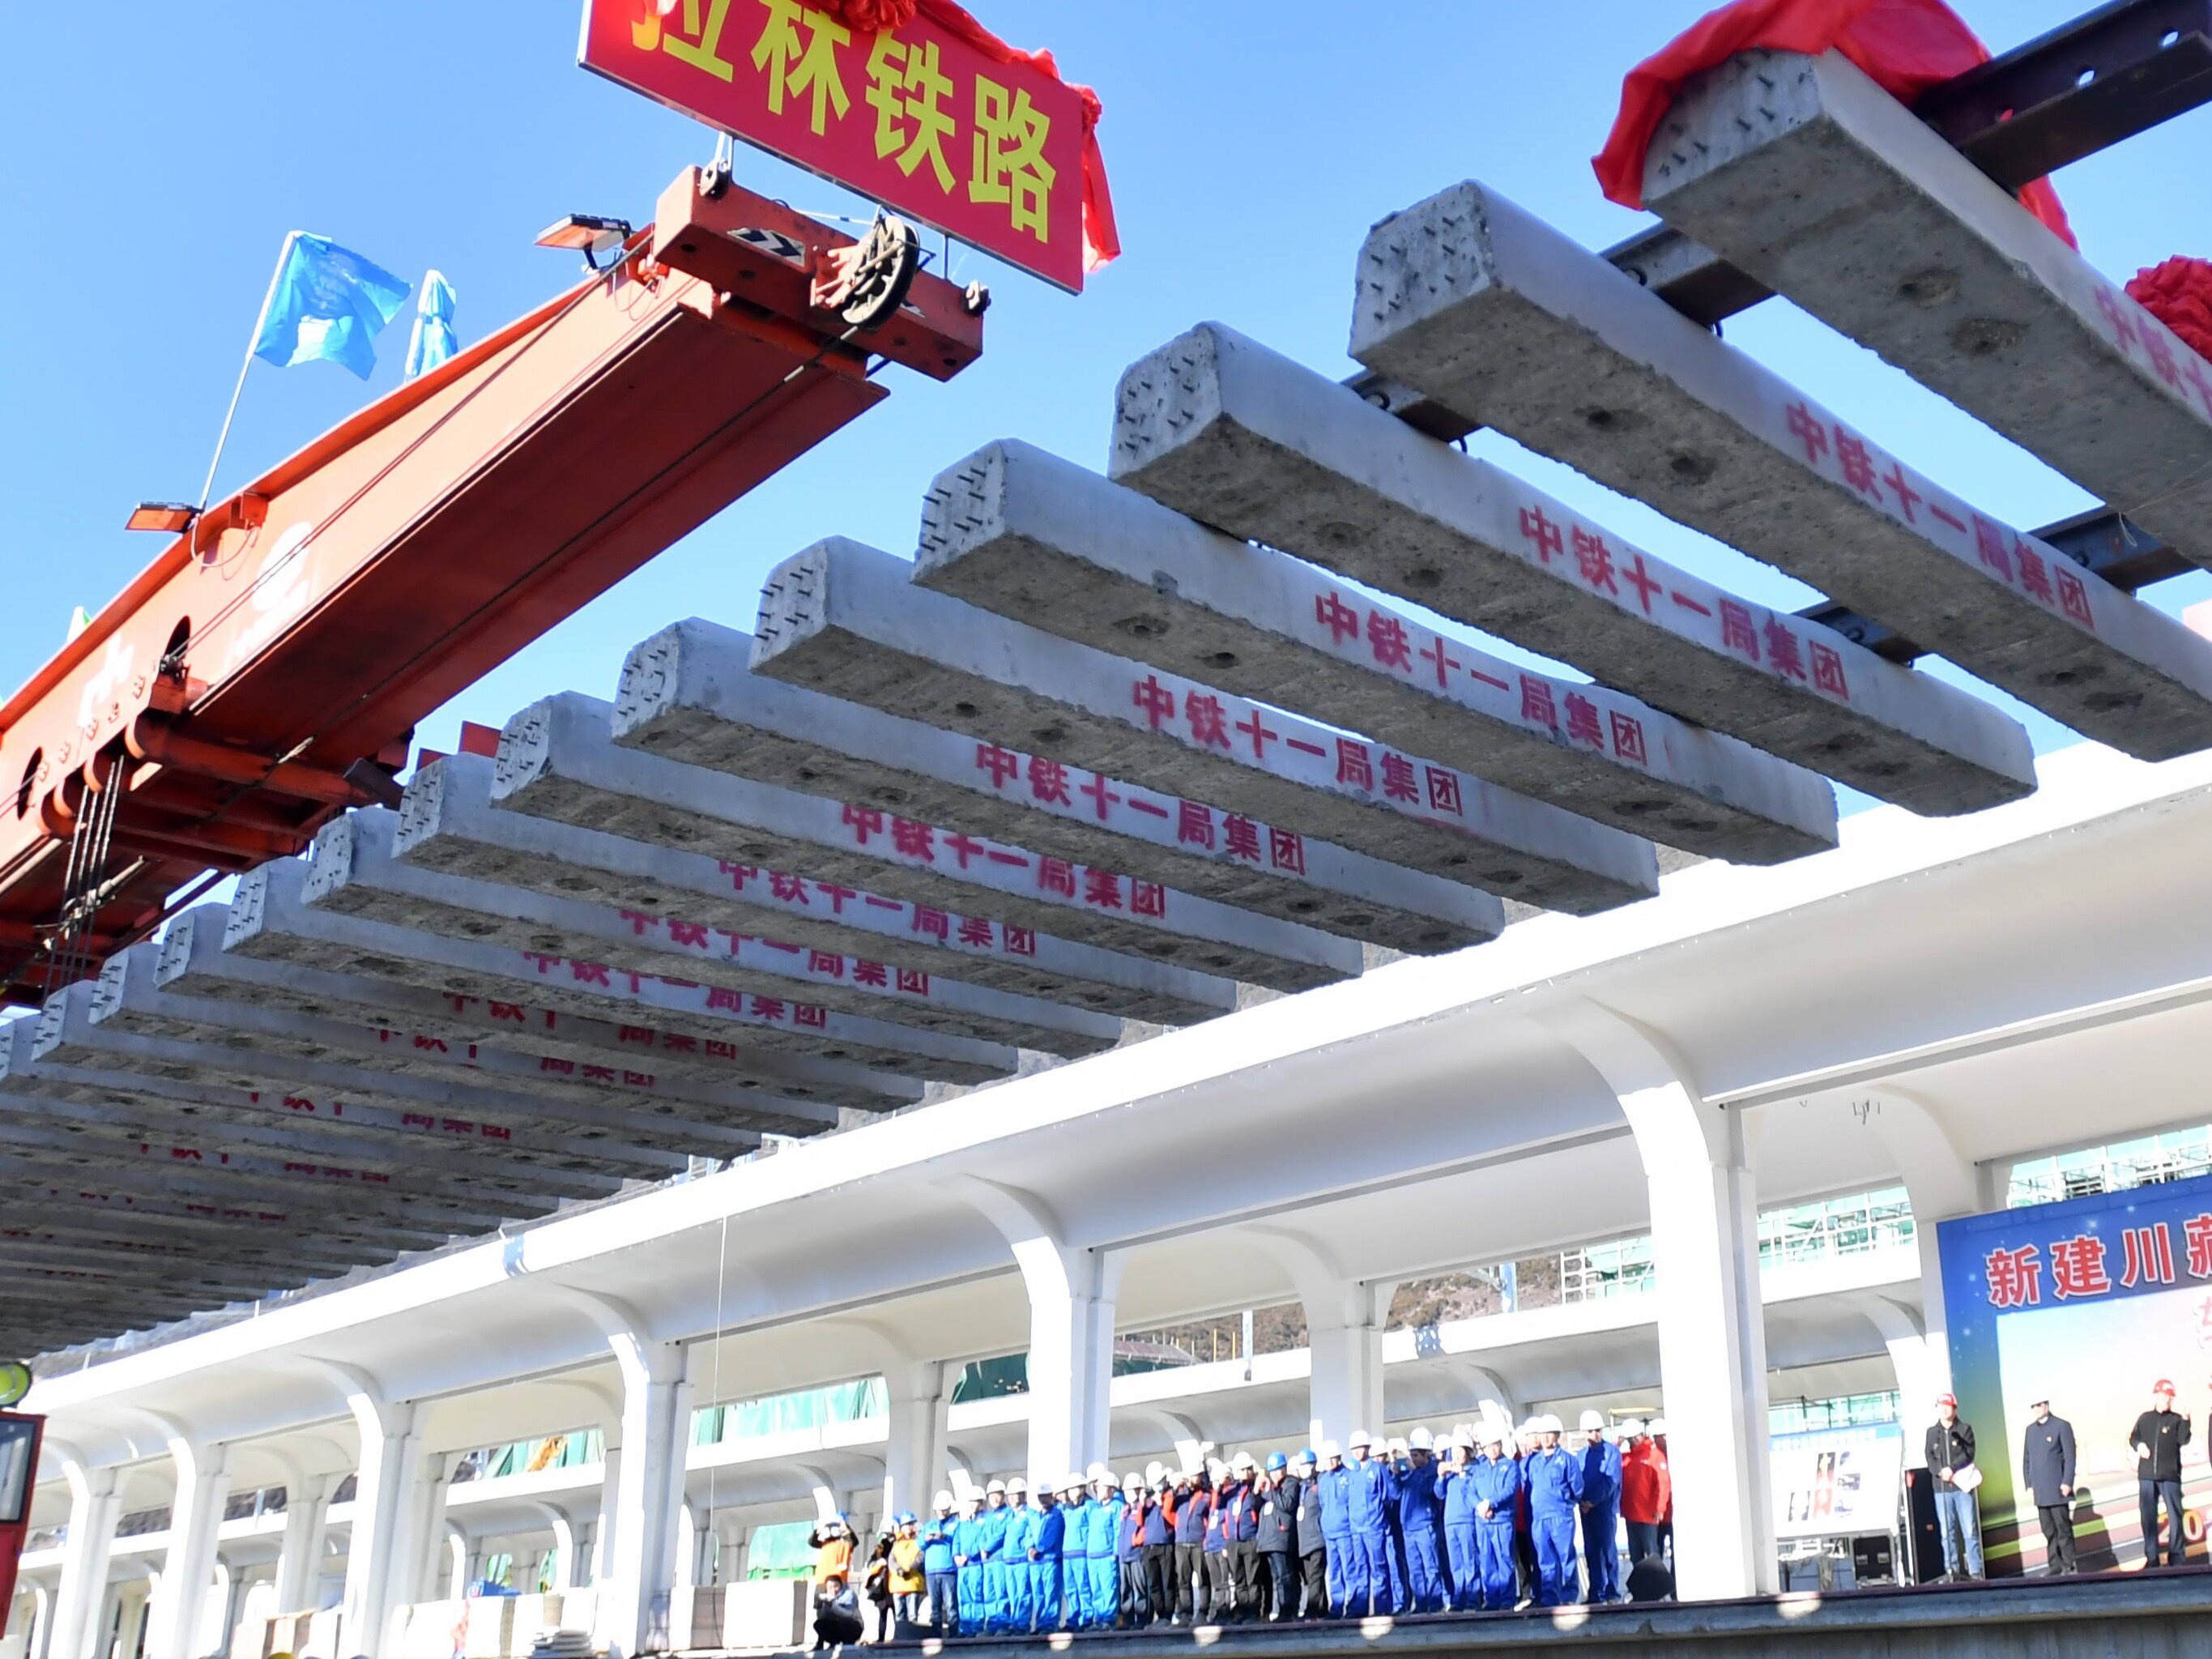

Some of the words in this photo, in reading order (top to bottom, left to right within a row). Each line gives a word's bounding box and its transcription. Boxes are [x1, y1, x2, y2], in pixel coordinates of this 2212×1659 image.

[1786, 402, 2095, 631] 中铁十一局集团
[1315, 591, 1647, 766] 中铁十一局集团
[1519, 505, 1849, 700] 中铁十一局集团
[976, 743, 1306, 876] 中铁十一局集团
[1133, 674, 1462, 816] 中铁十一局集团
[842, 804, 1166, 919] 中铁十一局集团
